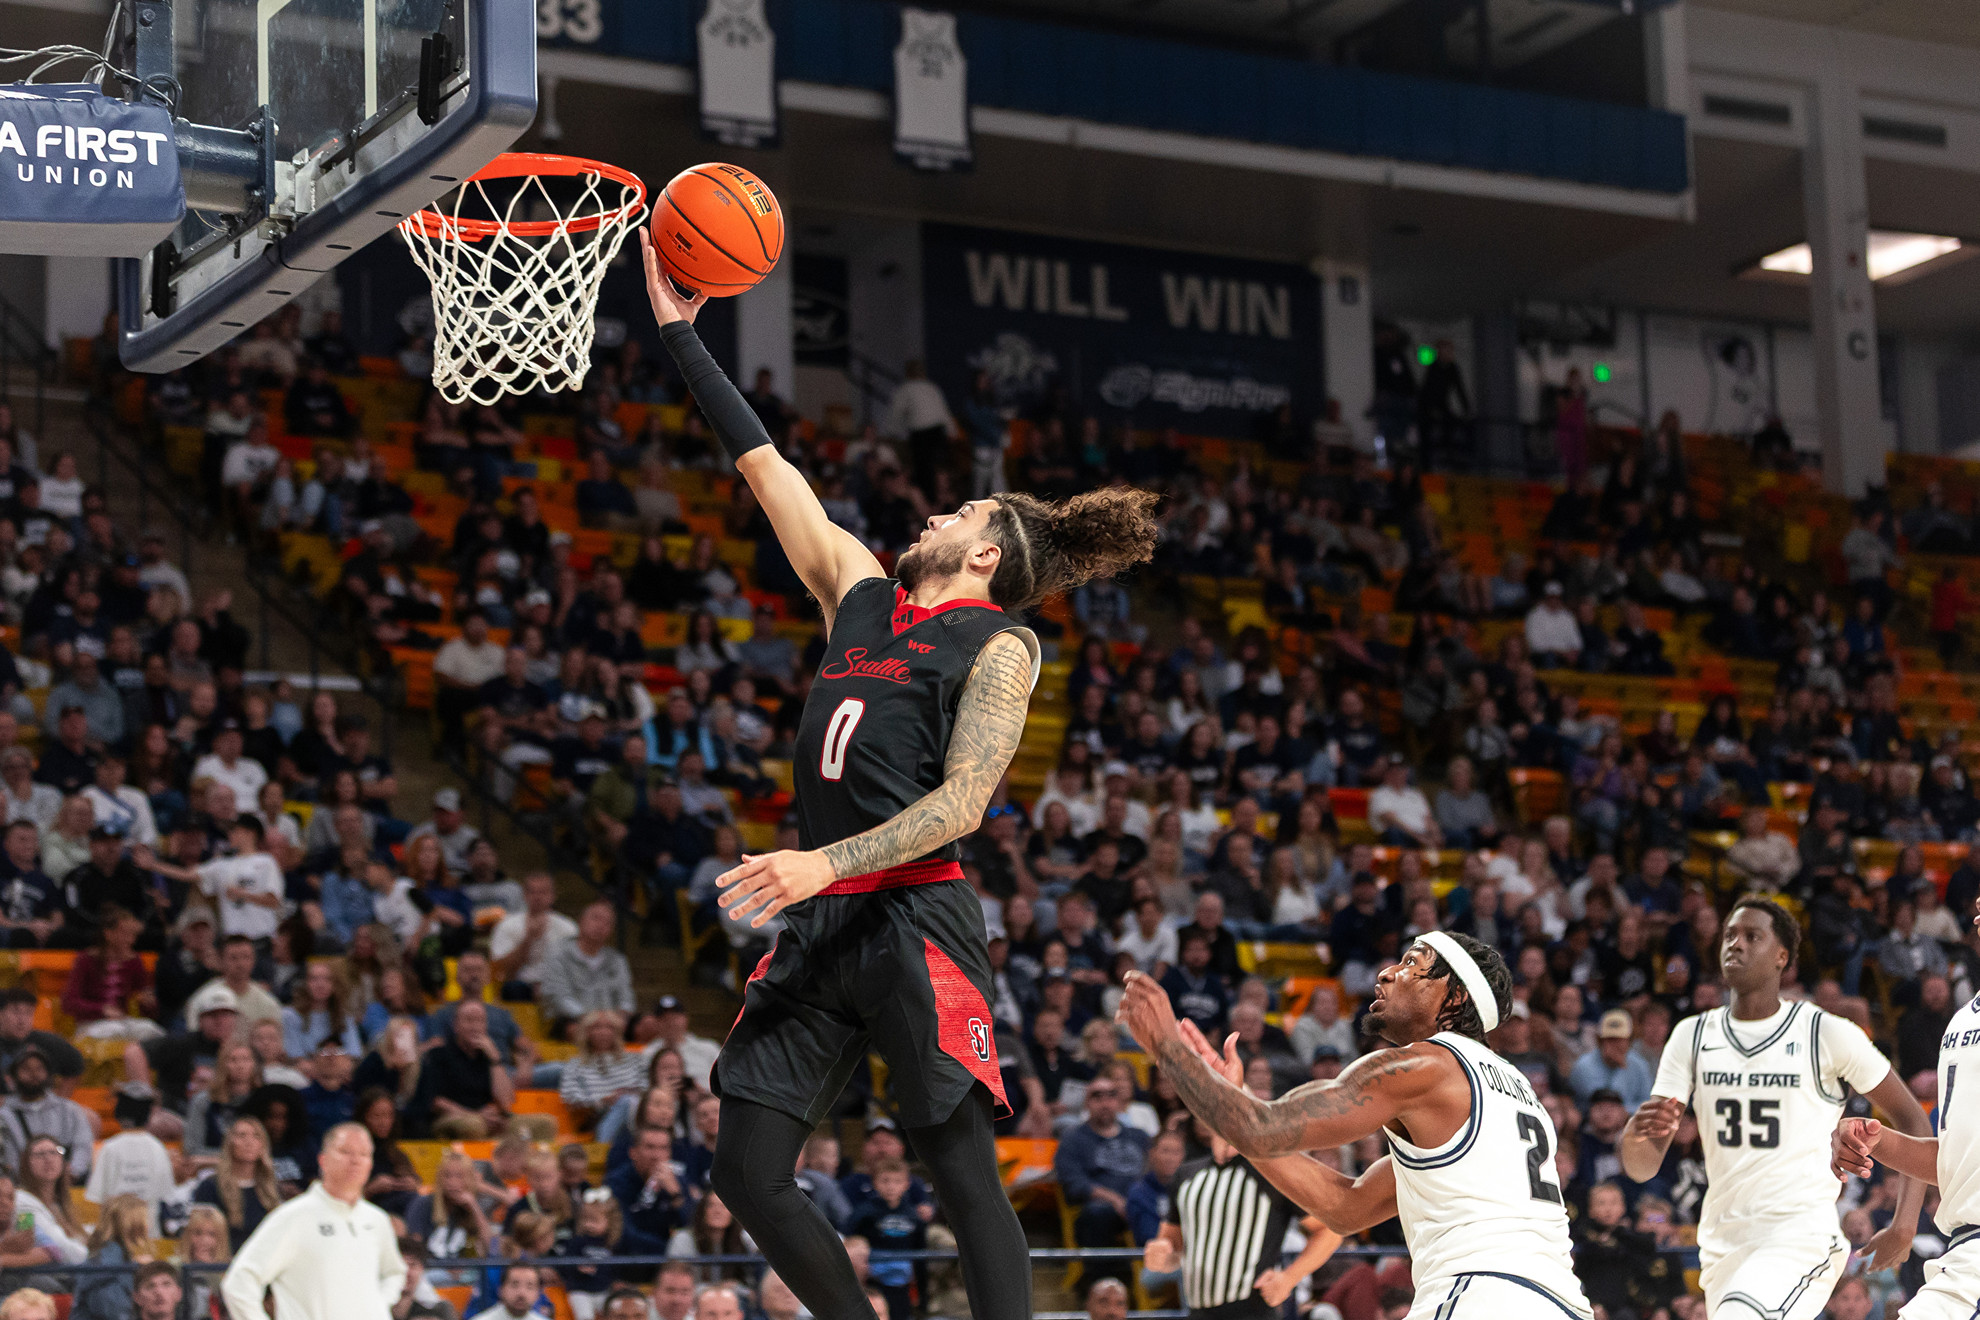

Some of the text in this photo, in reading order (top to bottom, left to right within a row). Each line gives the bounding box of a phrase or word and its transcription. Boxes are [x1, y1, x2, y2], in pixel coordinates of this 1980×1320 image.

[37, 125, 168, 166] FIRST
[18, 163, 134, 189] UNION
[718, 165, 772, 215] ELITE
[966, 251, 1290, 339] WILL WIN
[821, 647, 911, 685] Seattle
[820, 697, 865, 782] 0
[1703, 1072, 1801, 1088] UTAH STATE
[1715, 1098, 1780, 1149] 35
[1516, 1110, 1562, 1206] 2
